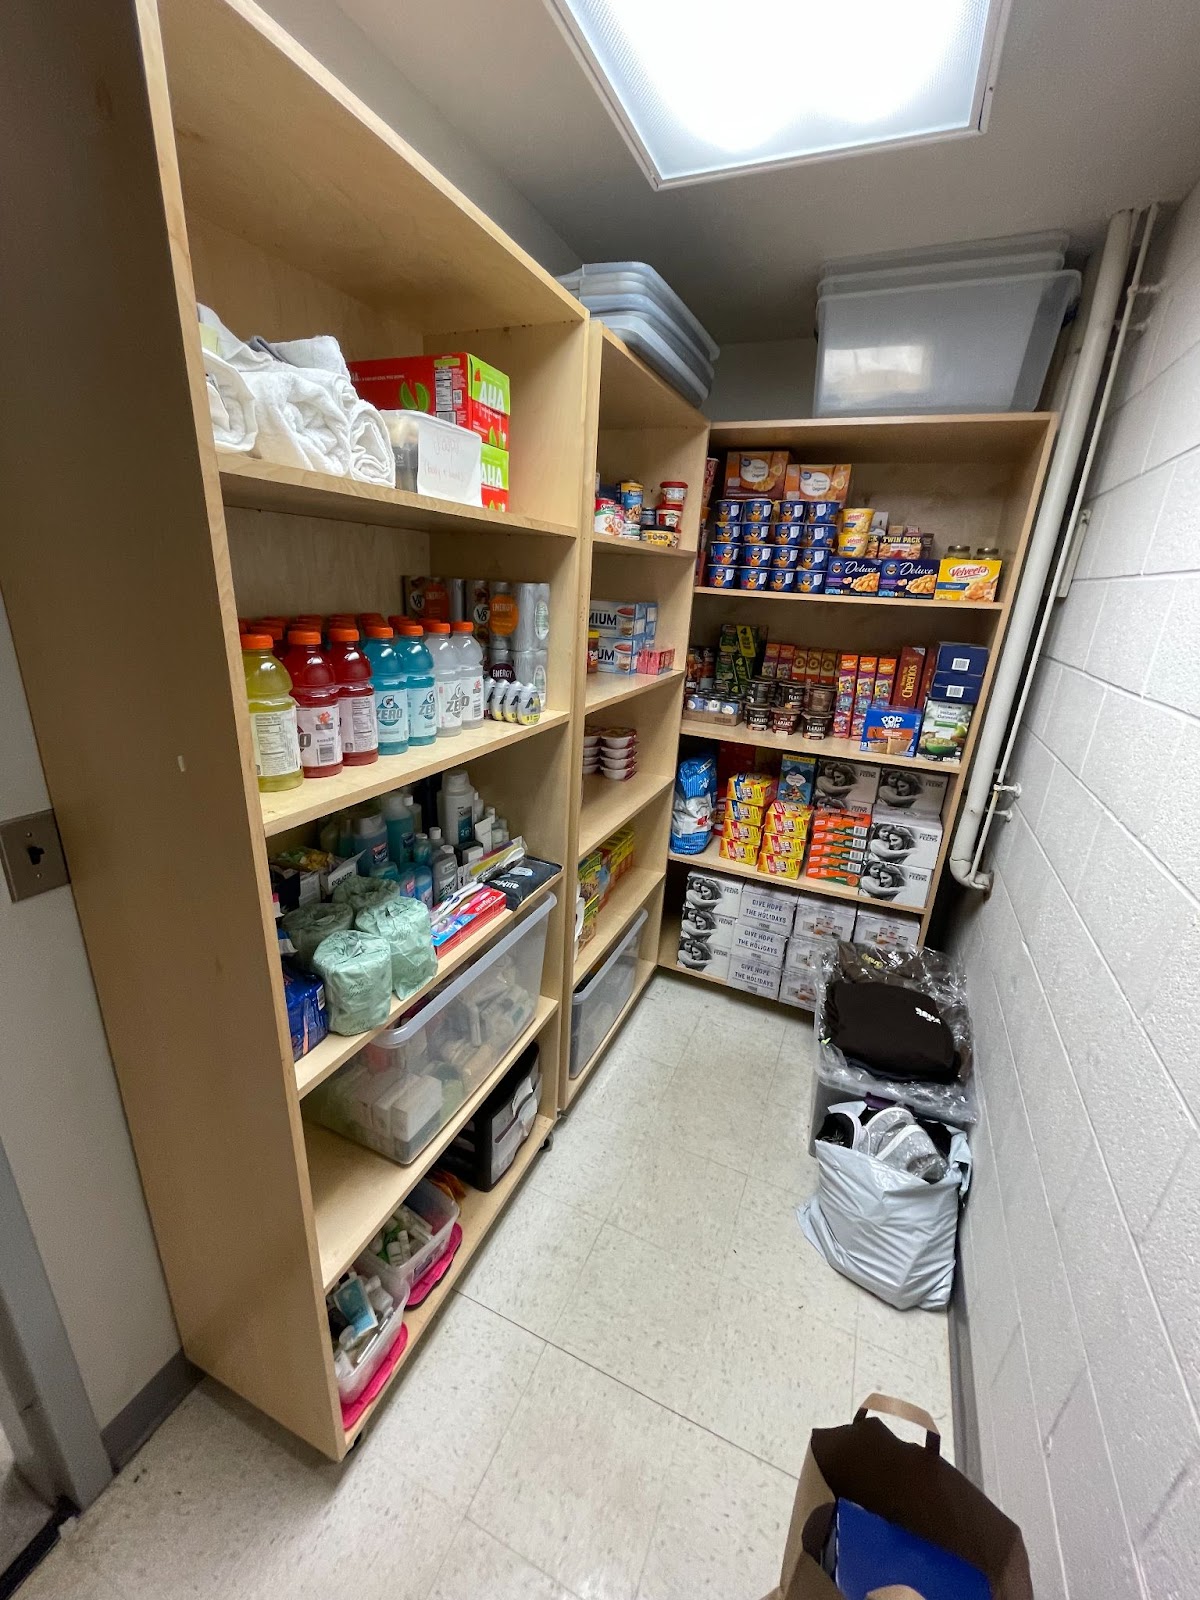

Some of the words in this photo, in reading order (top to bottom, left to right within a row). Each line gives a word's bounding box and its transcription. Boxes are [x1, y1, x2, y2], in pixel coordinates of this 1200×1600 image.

[480, 381, 505, 411] AHA
[481, 462, 503, 488] AHA
[902, 536, 921, 544] PACK
[845, 561, 877, 574] Deluxe
[900, 562, 934, 576] Deluxe
[950, 566, 988, 578] Velveeta
[492, 603, 513, 612] ENERGY
[476, 607, 489, 621] V8
[492, 669, 513, 678] ENERGY
[902, 665, 918, 698] Cheerios
[376, 708, 403, 720] ZERO
[752, 899, 766, 908] GIVE
[766, 902, 783, 912] HOPE
[746, 908, 756, 916] THE
[744, 930, 758, 938] GIVE
[758, 933, 774, 942] HOPE
[738, 938, 748, 947] THE
[734, 972, 746, 980] THE
[740, 964, 754, 972] GIVE
[754, 966, 770, 976] HOPE
